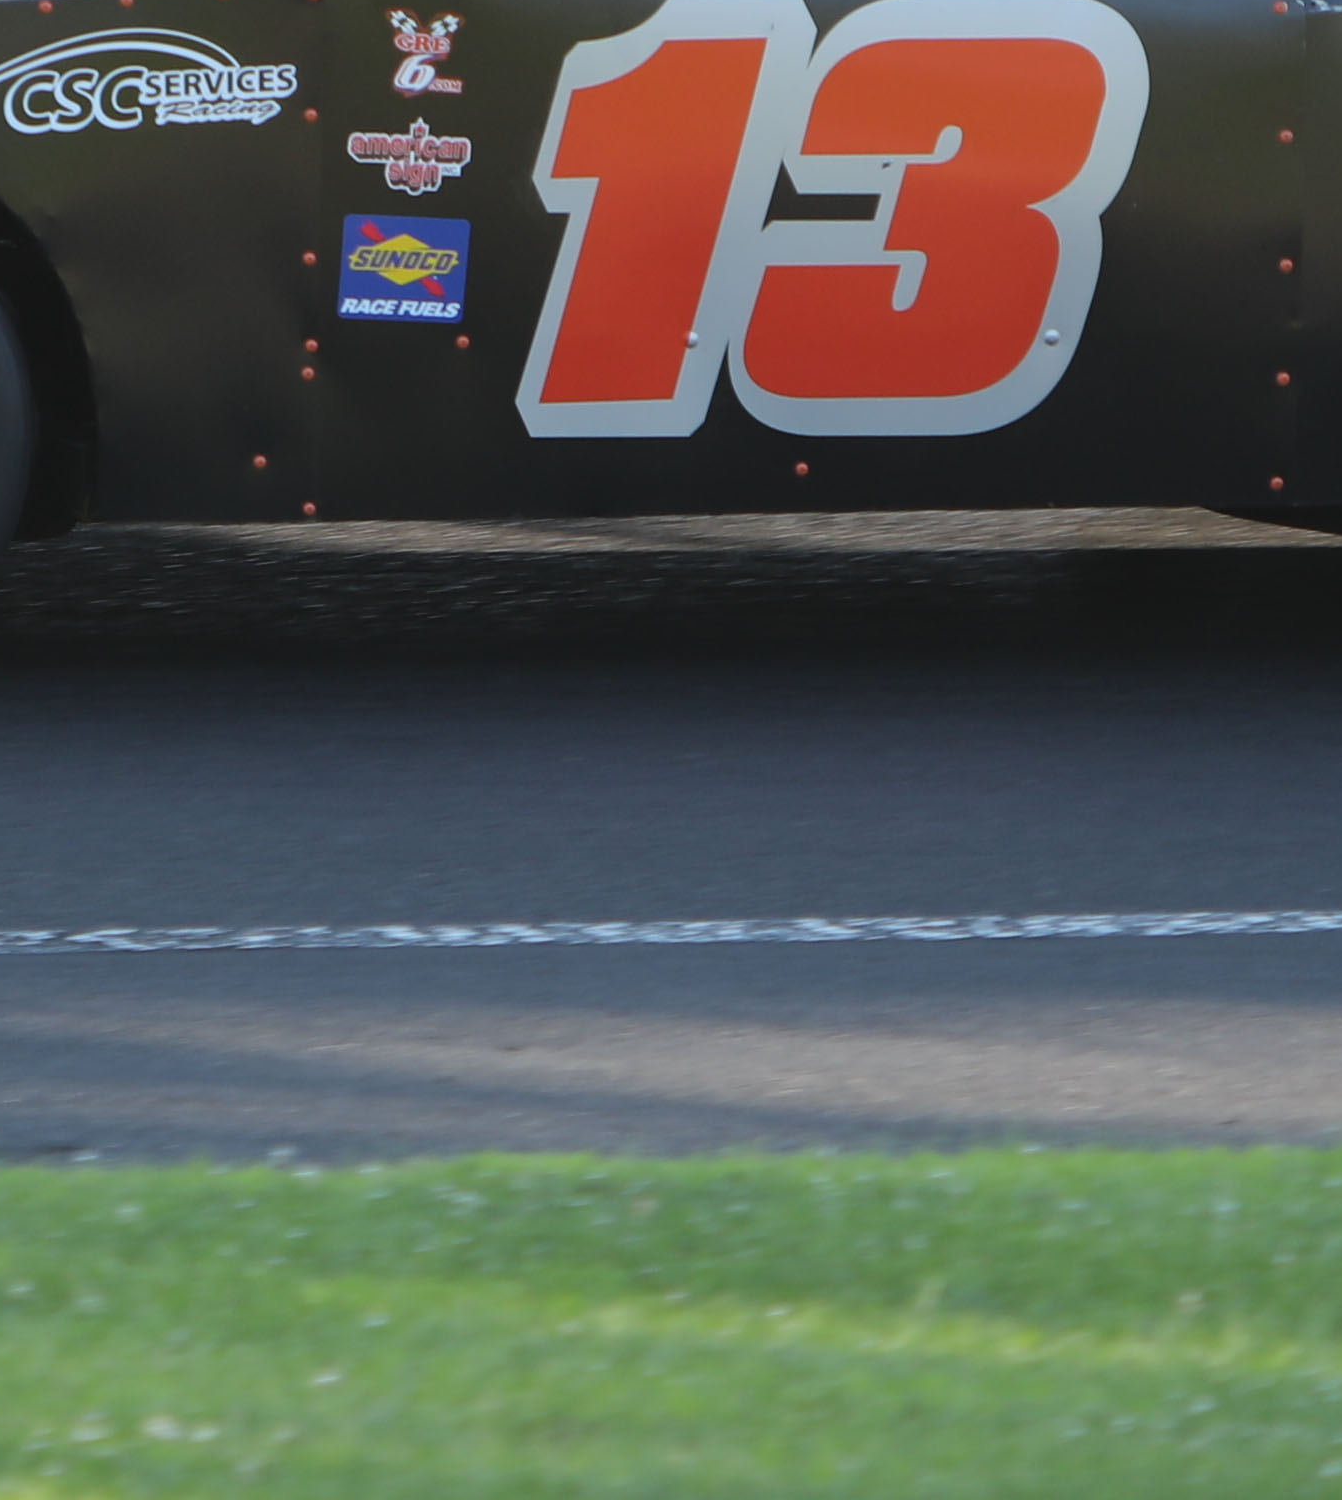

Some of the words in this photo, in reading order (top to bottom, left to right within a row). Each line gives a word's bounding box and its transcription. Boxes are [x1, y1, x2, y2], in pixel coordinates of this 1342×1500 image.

[4, 64, 144, 135] CSC
[142, 65, 297, 103] SERVICES
[156, 100, 281, 126] Racing
[349, 132, 470, 161] american
[387, 160, 441, 193] sign
[352, 249, 455, 272] SUNOCO
[340, 297, 397, 316] RACE
[397, 299, 461, 319] FUELS
